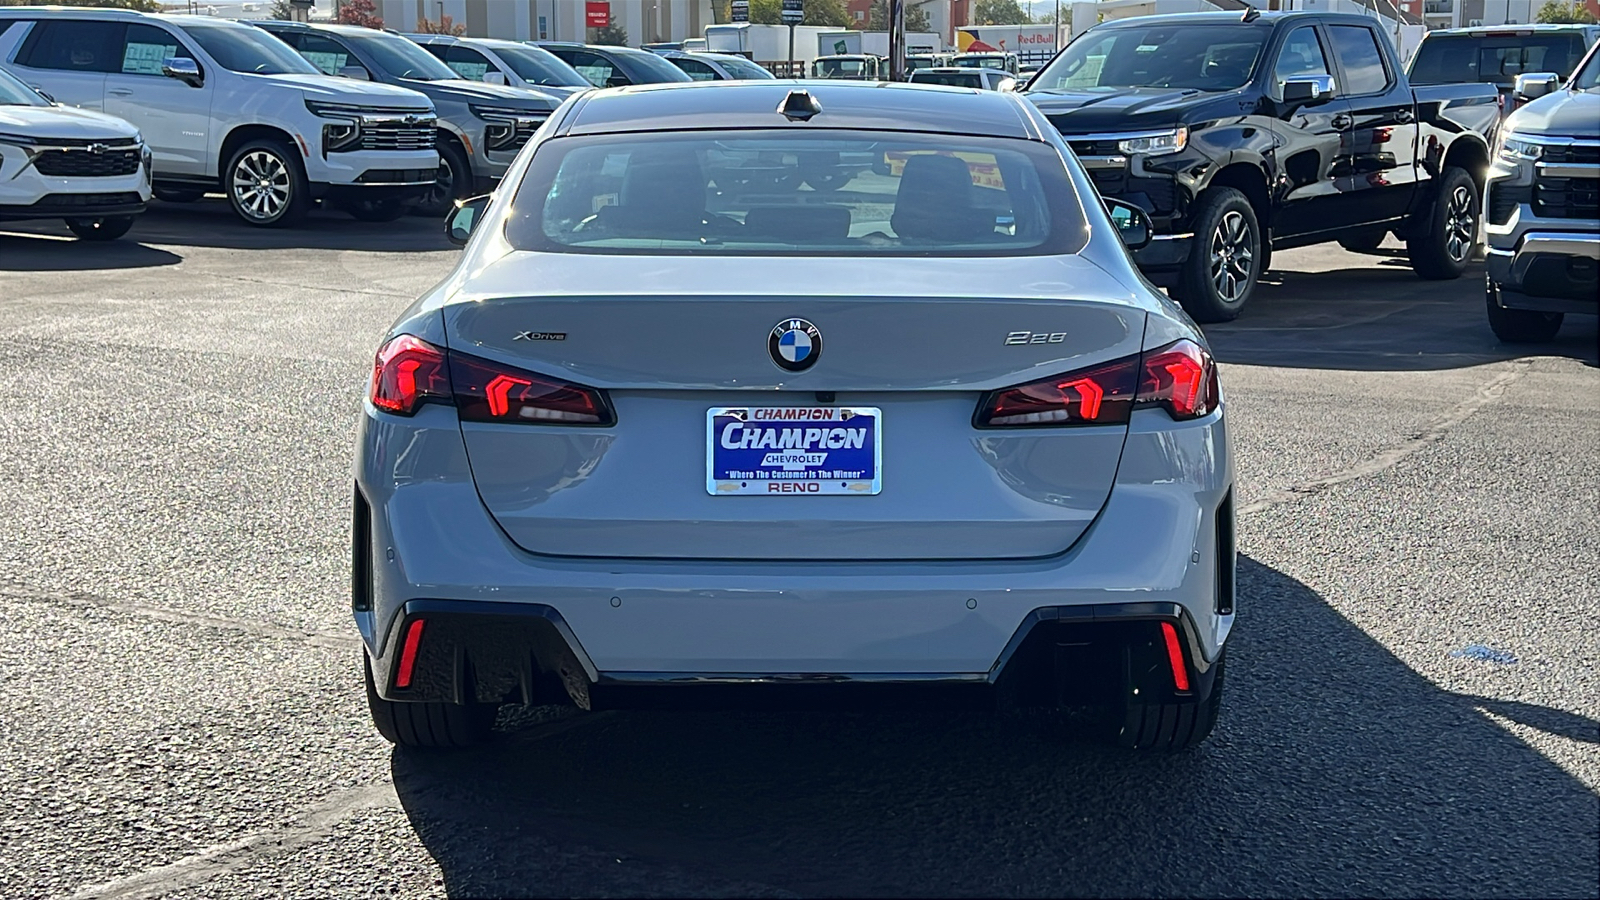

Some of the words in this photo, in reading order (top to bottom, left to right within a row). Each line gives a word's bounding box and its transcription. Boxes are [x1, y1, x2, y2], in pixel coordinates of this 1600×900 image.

[1018, 35, 1036, 44] Red
[1037, 34, 1054, 44] Bull
[773, 320, 818, 338] BMW
[1004, 331, 1067, 346] 228
[754, 408, 834, 420] CHAMPION
[720, 422, 867, 450] CHAMPION
[765, 455, 823, 463] CHEVROLET
[756, 470, 770, 479] The
[771, 470, 808, 479] Customer
[809, 471, 817, 479] Is
[818, 470, 832, 479] The
[768, 482, 820, 493] RENO
